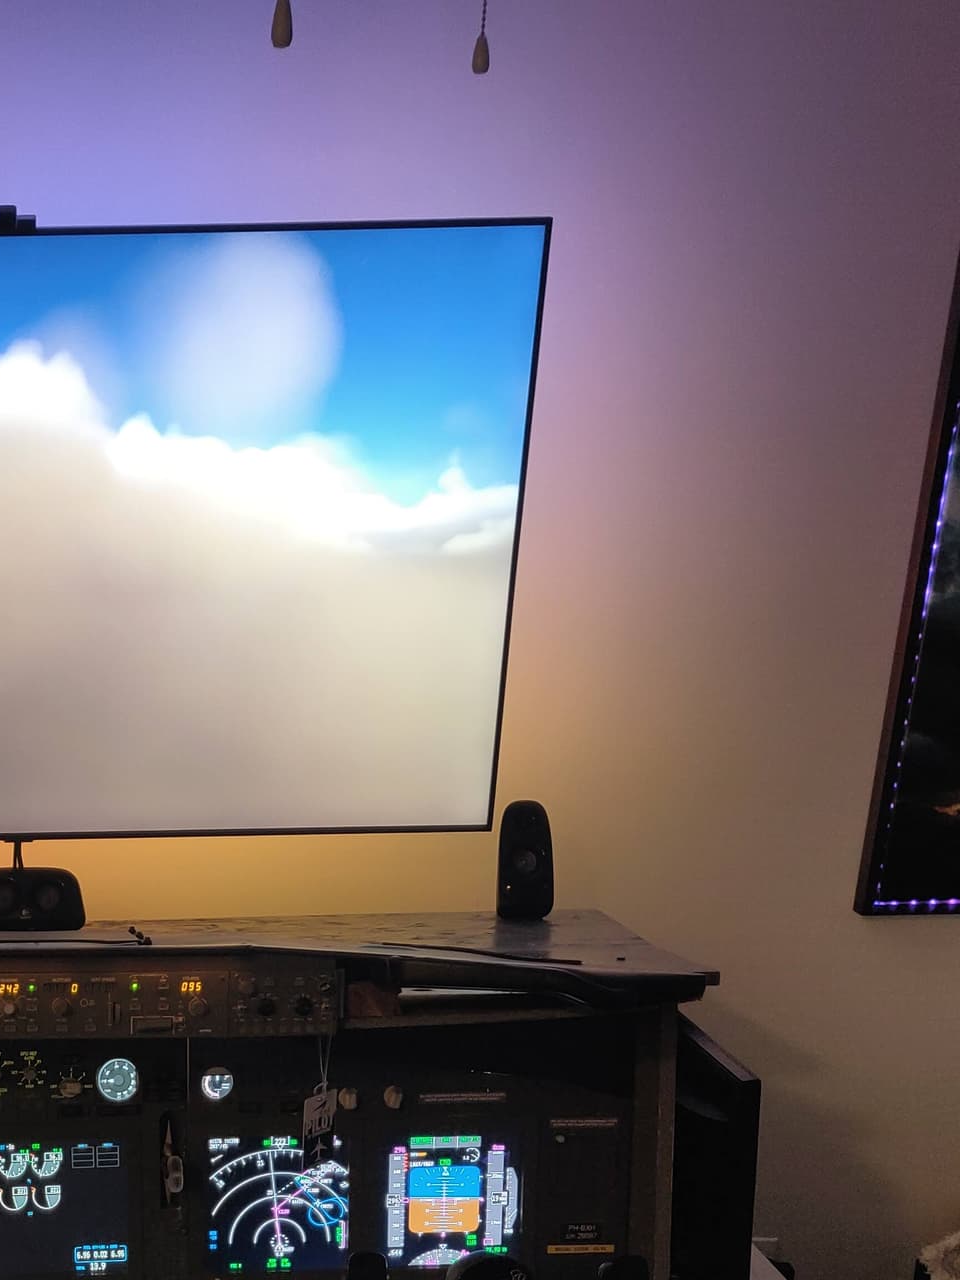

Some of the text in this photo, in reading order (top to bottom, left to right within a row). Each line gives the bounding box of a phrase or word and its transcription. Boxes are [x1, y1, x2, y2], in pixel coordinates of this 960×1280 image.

[0, 984, 19, 994] 242
[71, 984, 78, 993] 0
[181, 981, 202, 992] 095
